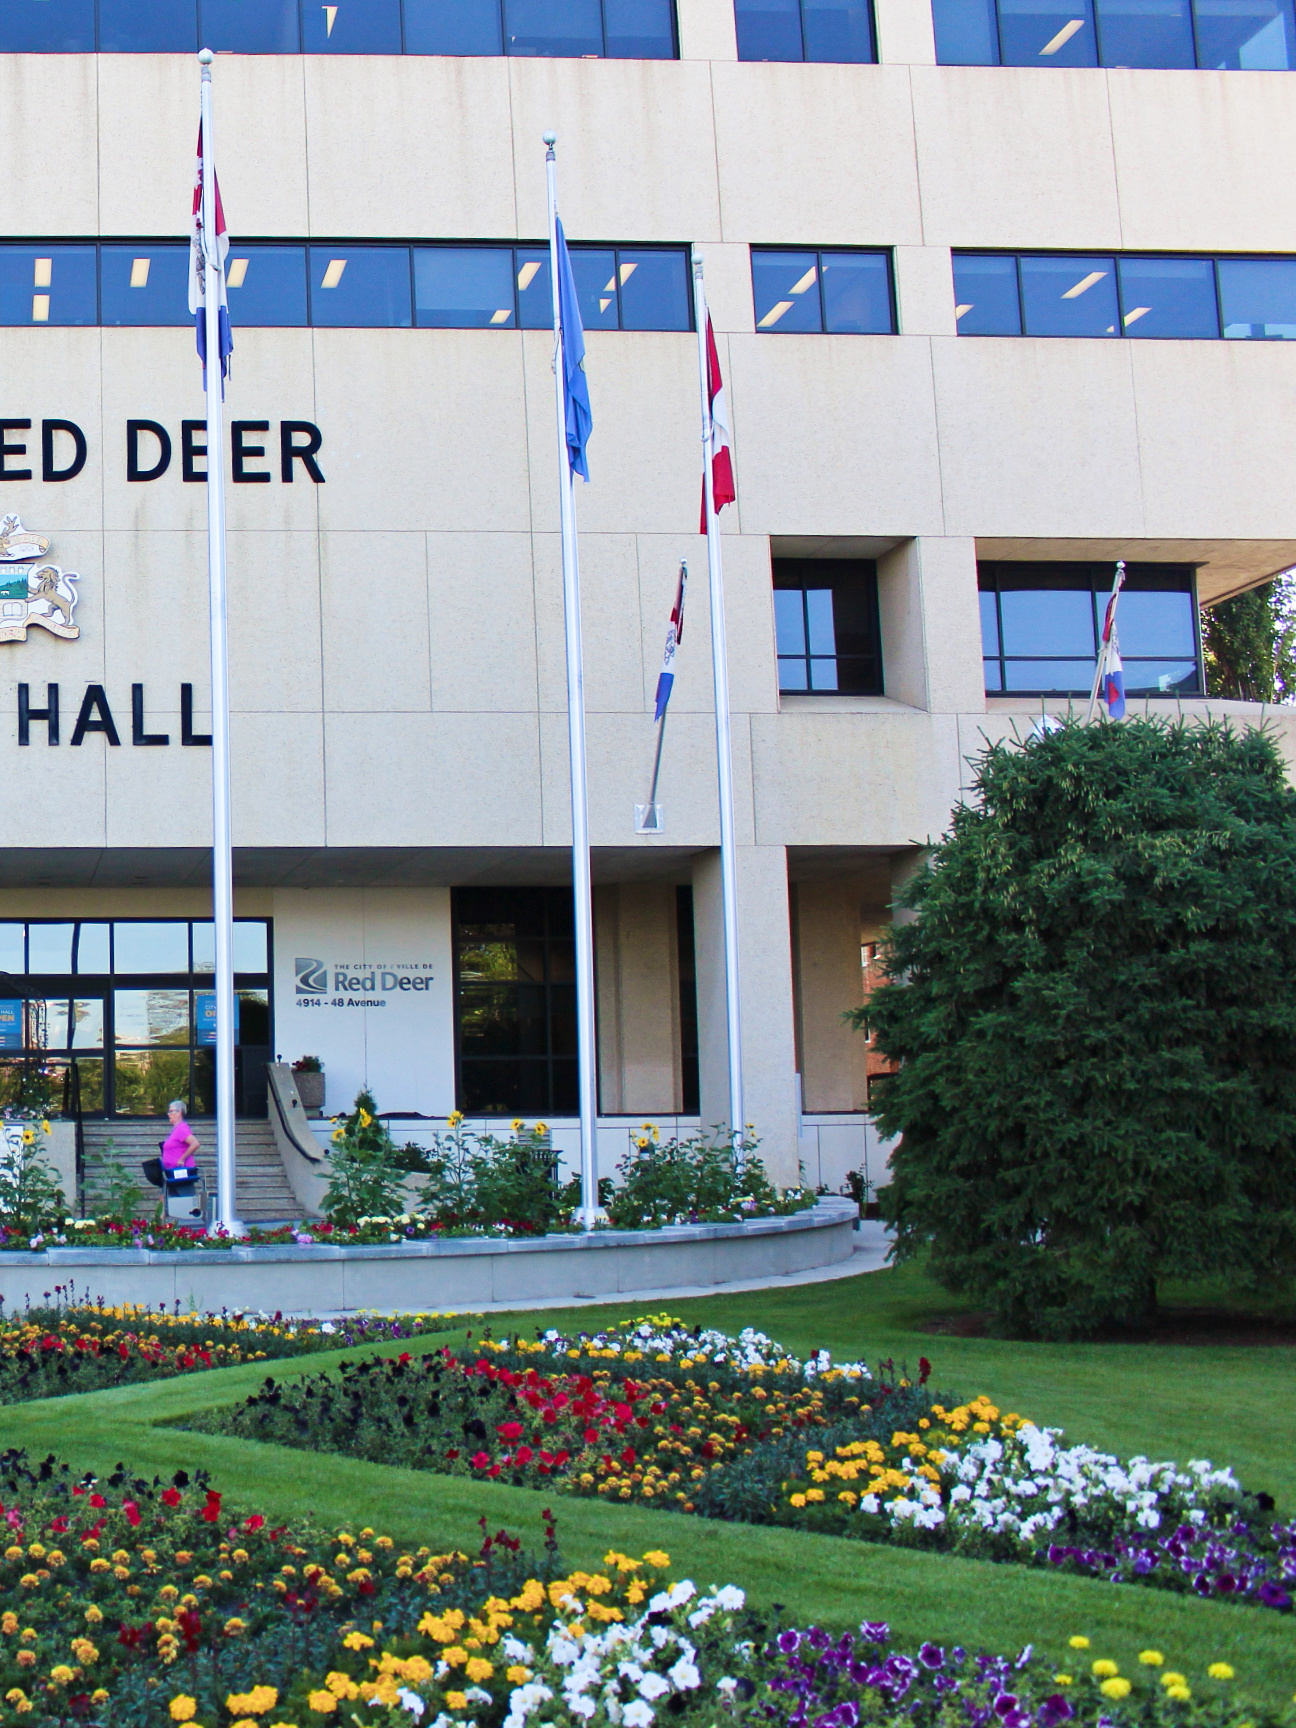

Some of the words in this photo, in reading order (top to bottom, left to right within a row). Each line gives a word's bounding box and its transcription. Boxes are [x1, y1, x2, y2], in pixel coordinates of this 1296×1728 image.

[126, 419, 326, 483] DEER
[18, 682, 213, 747] HALL
[334, 971, 375, 991] Red
[381, 971, 434, 991] Deer
[295, 998, 321, 1007] 4914
[330, 998, 344, 1007] 48
[346, 998, 387, 1007] Avenue
